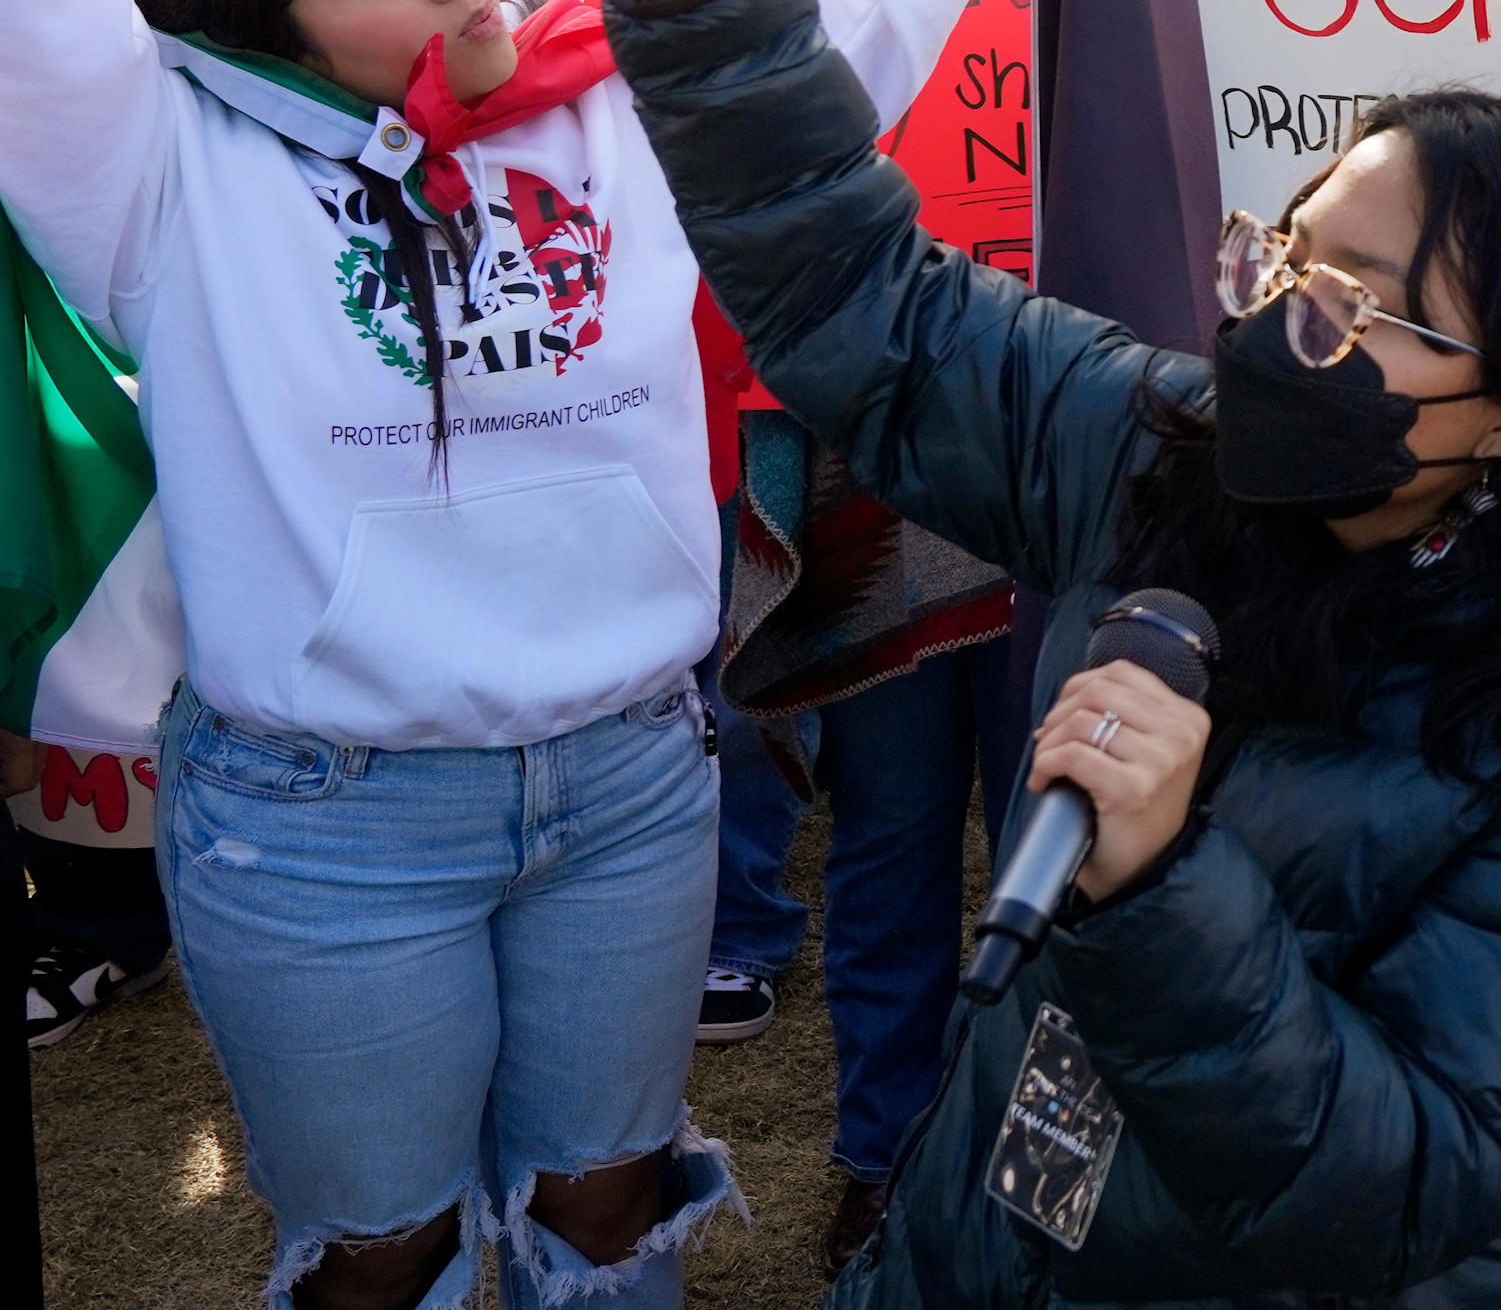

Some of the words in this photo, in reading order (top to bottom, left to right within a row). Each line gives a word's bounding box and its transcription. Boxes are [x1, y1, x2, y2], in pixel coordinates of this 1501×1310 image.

[1222, 85, 1416, 155] PROT
[425, 323, 572, 379] PAIS
[331, 423, 423, 446] PROTECT
[470, 406, 573, 435] IMMIGRANT
[577, 384, 650, 423] CHILDREN
